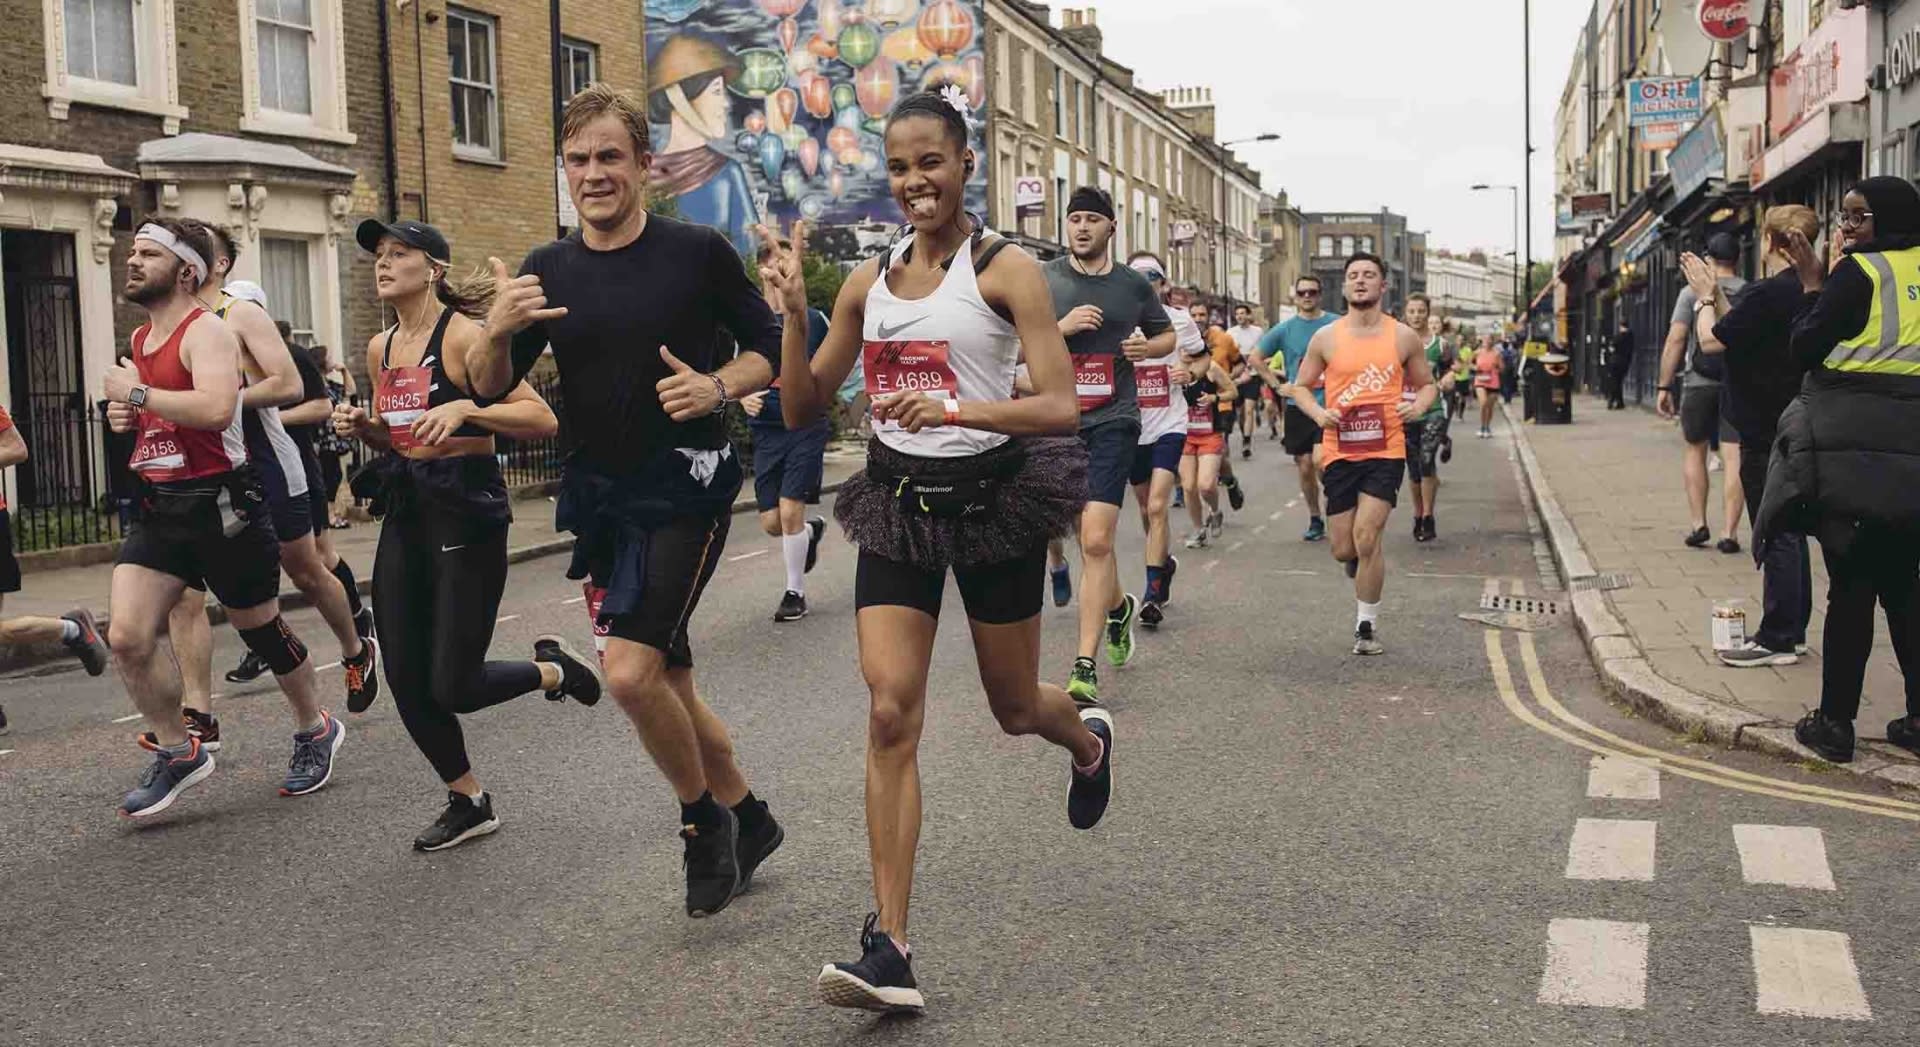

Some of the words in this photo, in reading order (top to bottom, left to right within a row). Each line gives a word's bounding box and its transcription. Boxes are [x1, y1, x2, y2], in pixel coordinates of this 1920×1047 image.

[1641, 80, 1690, 98] OFF
[876, 374, 890, 391] E
[895, 371, 943, 391] 4689
[1076, 372, 1106, 384] 3229
[1370, 362, 1394, 392] OUT
[380, 392, 420, 411] C16425
[1349, 419, 1381, 431] 10722
